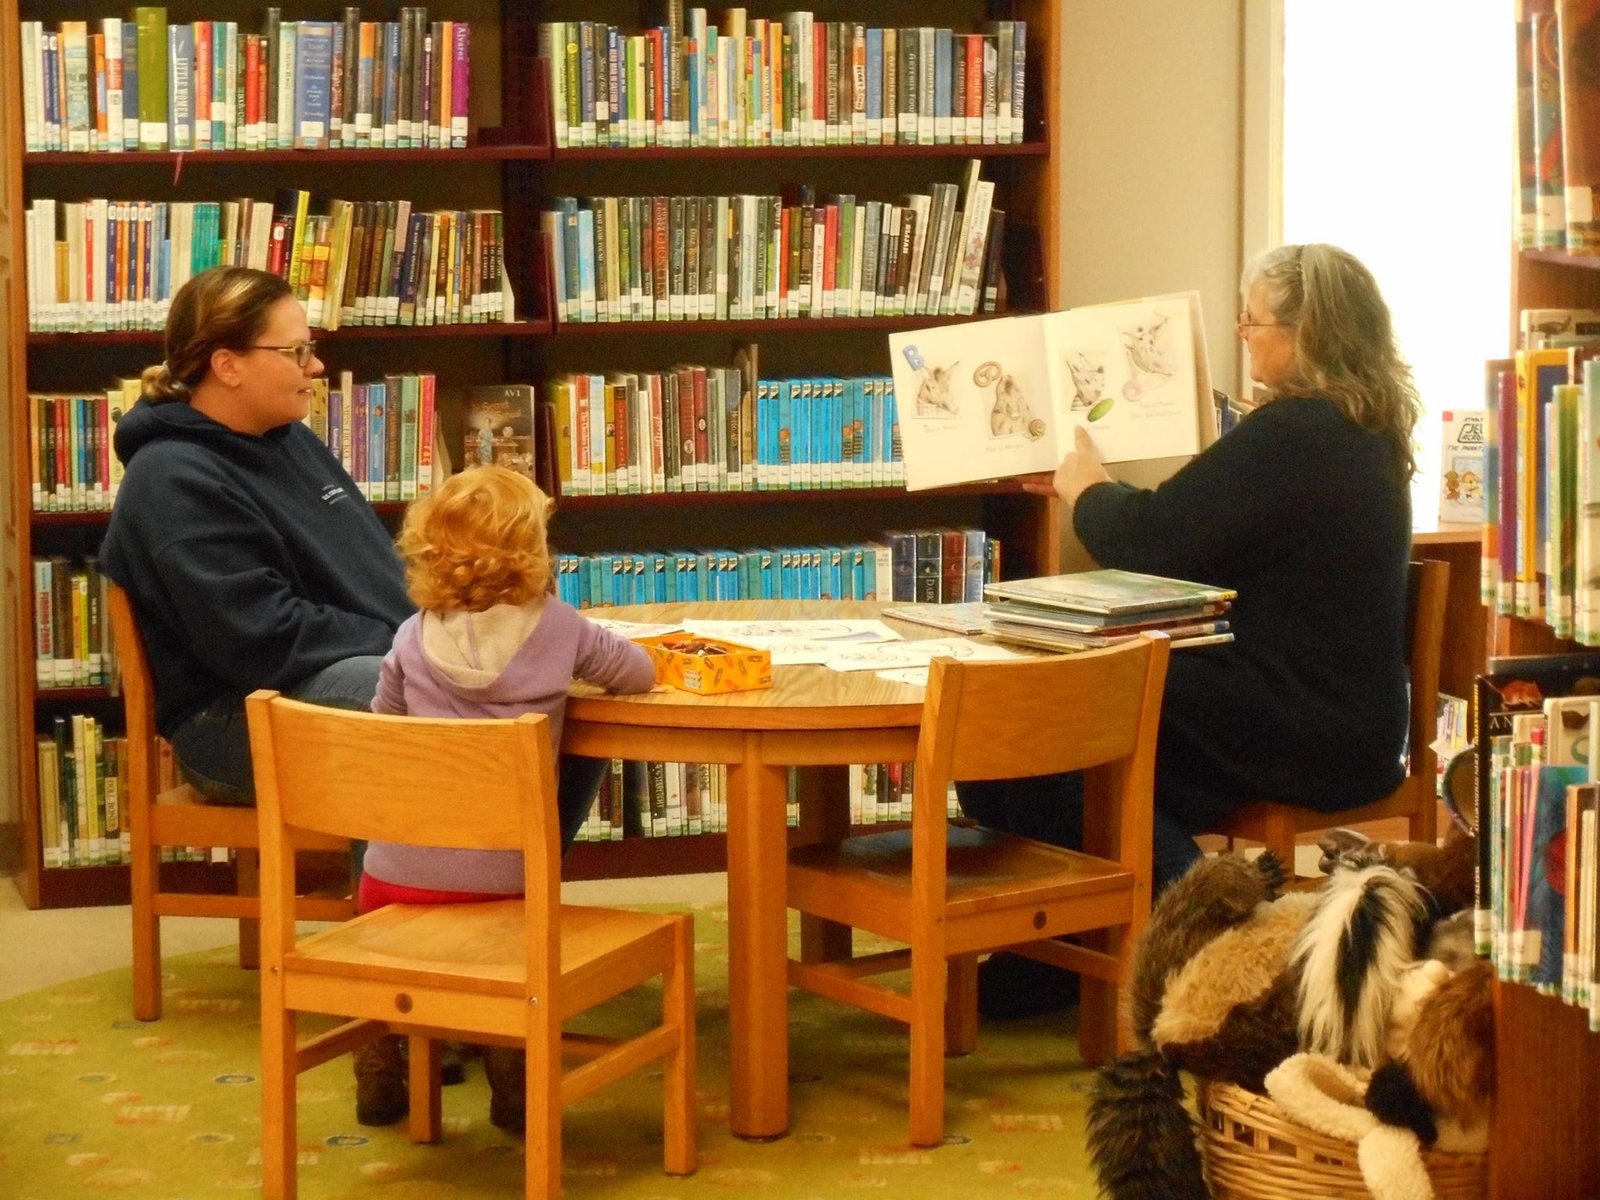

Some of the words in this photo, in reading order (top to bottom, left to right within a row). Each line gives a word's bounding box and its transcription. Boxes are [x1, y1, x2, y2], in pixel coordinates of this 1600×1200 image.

[457, 27, 467, 62] Alvarez
[175, 57, 189, 86] LITTLE
[908, 53, 917, 90] ARTEMIS
[1016, 70, 1025, 88] JUST
[174, 88, 189, 118] WOMEN
[908, 94, 916, 113] FOW
[986, 70, 996, 108] AIRMAN
[1016, 89, 1025, 119] IMAGIN
[902, 224, 911, 254] ELIJAH
[504, 389, 520, 397] AVI
[926, 579, 936, 601] DARK
